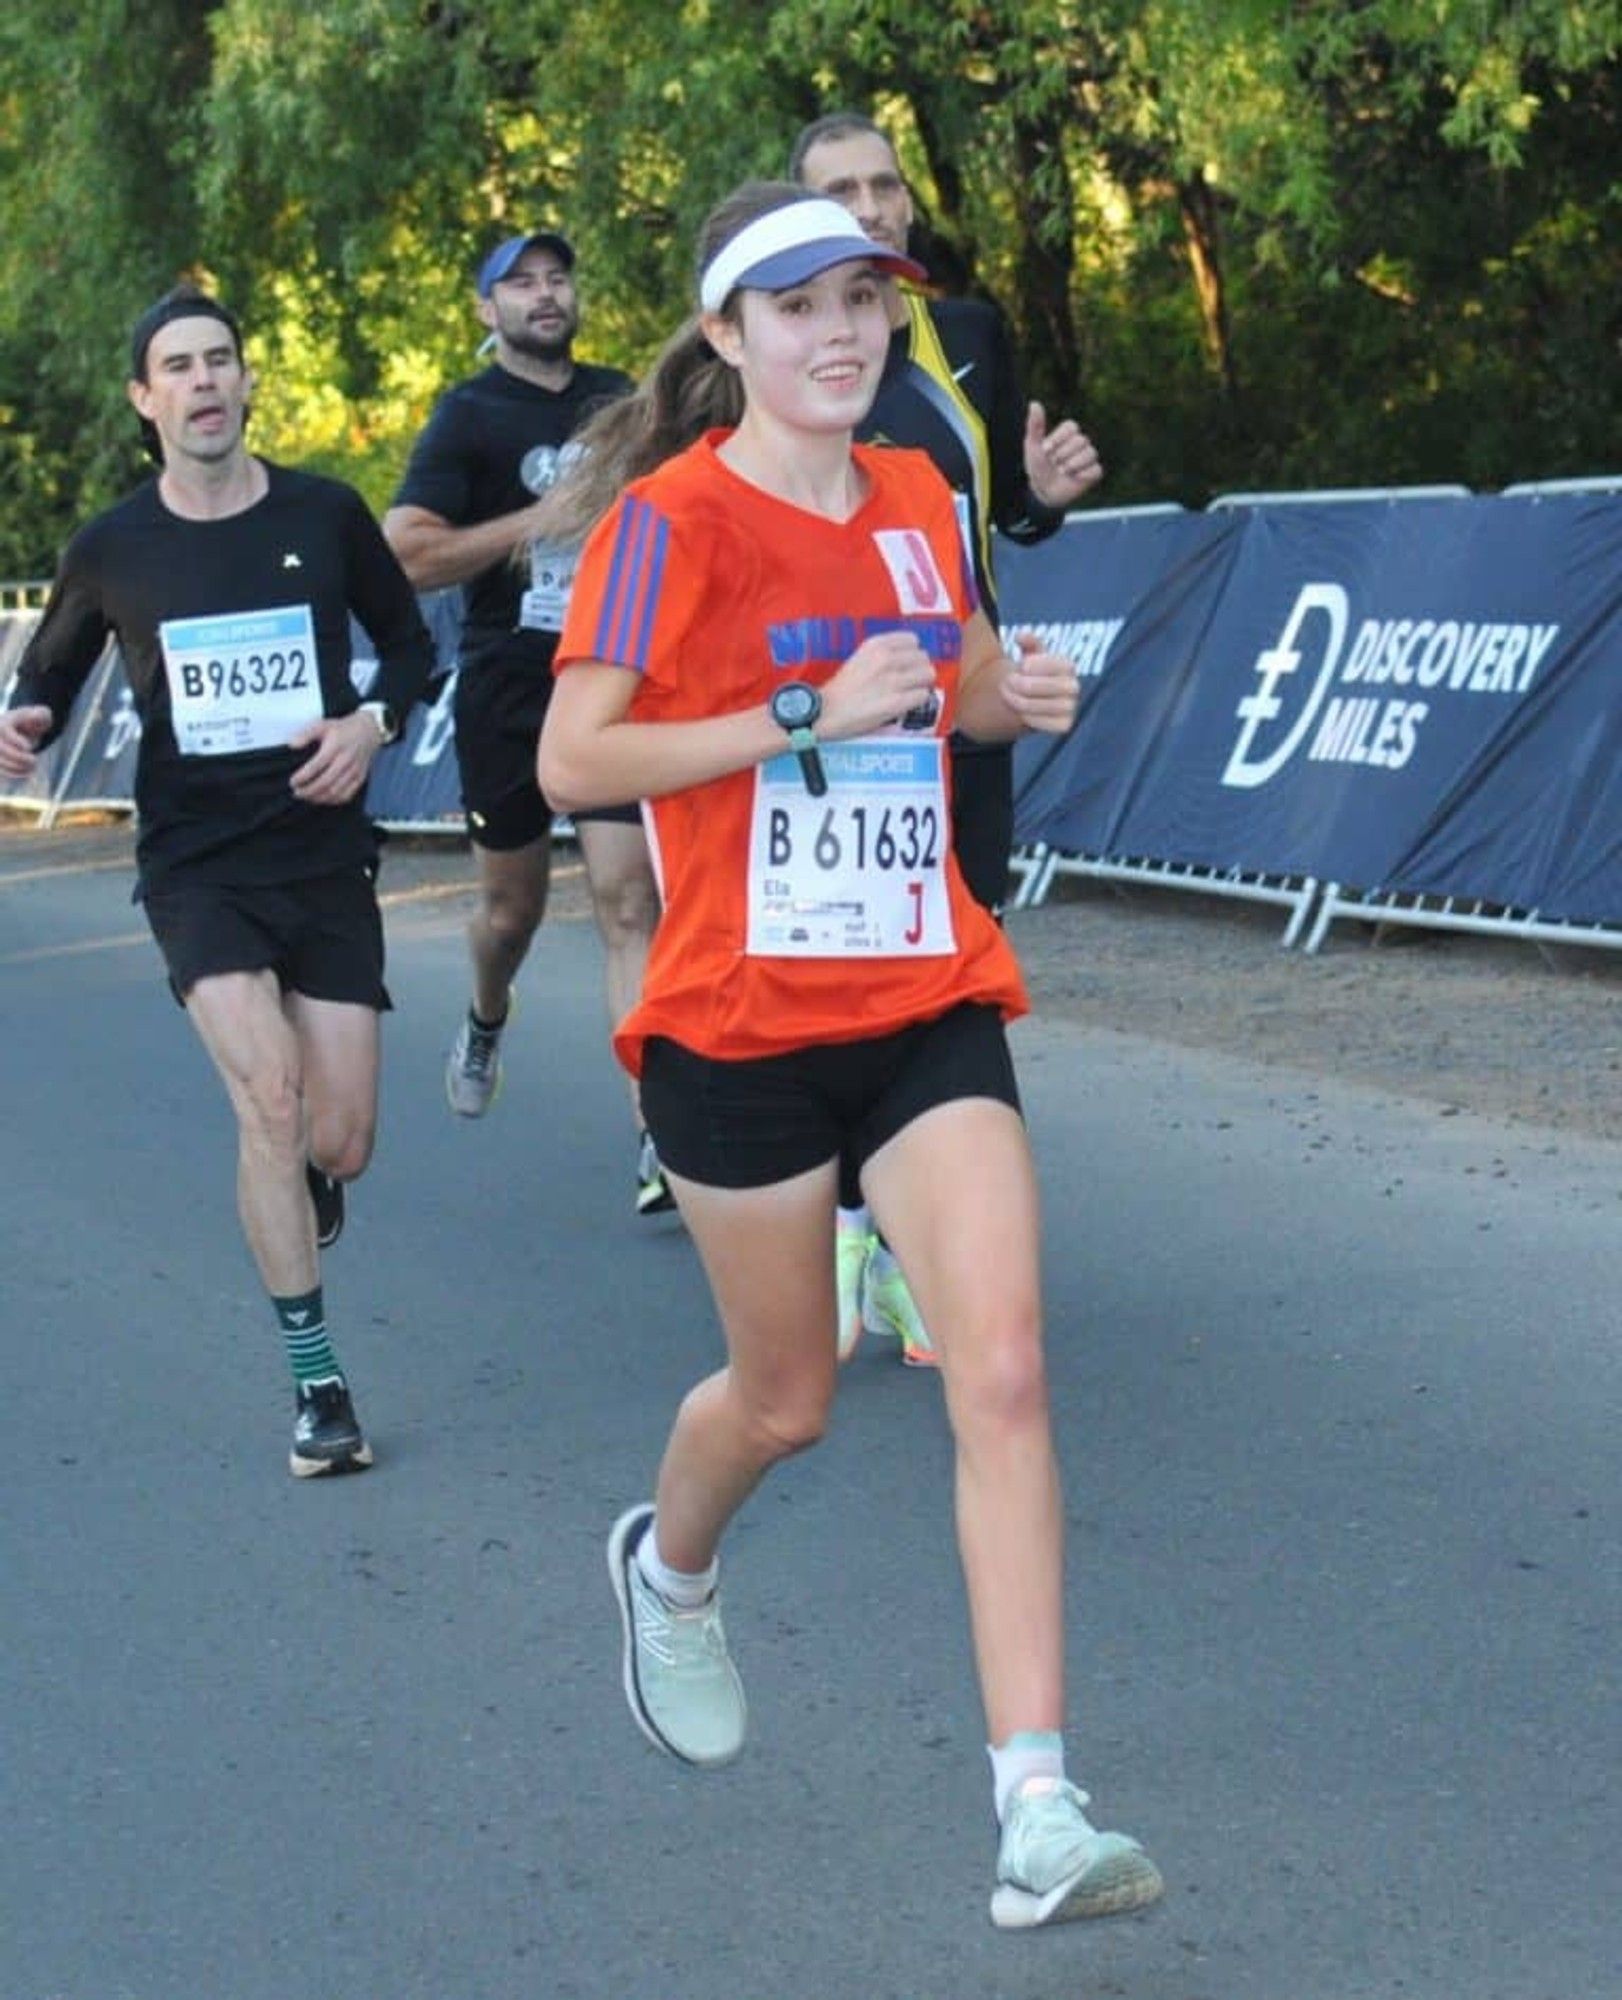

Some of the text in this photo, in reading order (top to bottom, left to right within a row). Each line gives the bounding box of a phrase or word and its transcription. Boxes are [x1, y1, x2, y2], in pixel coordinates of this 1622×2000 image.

[181, 649, 309, 699] B96322
[1340, 618, 1560, 693] DISCOVERY
[1307, 697, 1430, 770] MILES
[769, 805, 938, 871] B 61632
